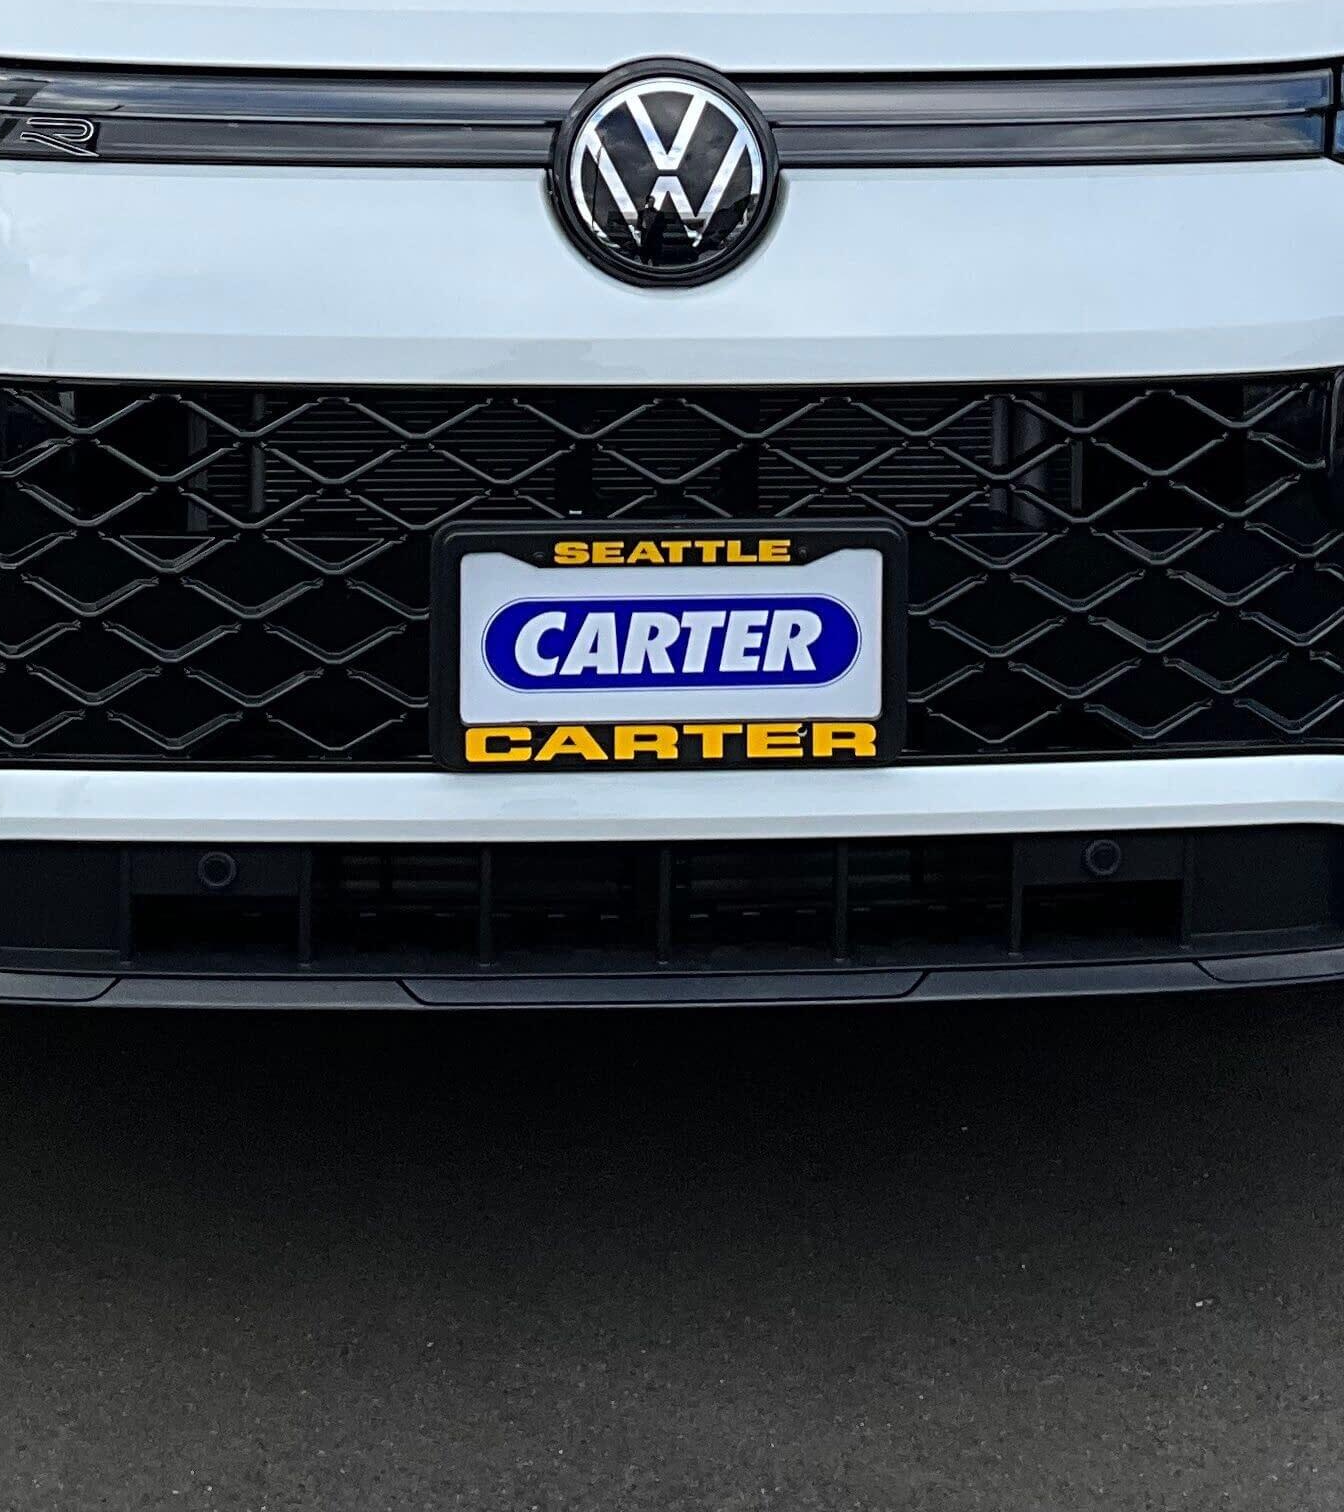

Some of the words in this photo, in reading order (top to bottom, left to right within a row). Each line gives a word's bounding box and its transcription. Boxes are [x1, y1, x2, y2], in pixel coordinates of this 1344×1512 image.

[553, 539, 792, 564] SEATTLE
[513, 608, 822, 677] CARTER
[464, 722, 877, 764] CARTER
